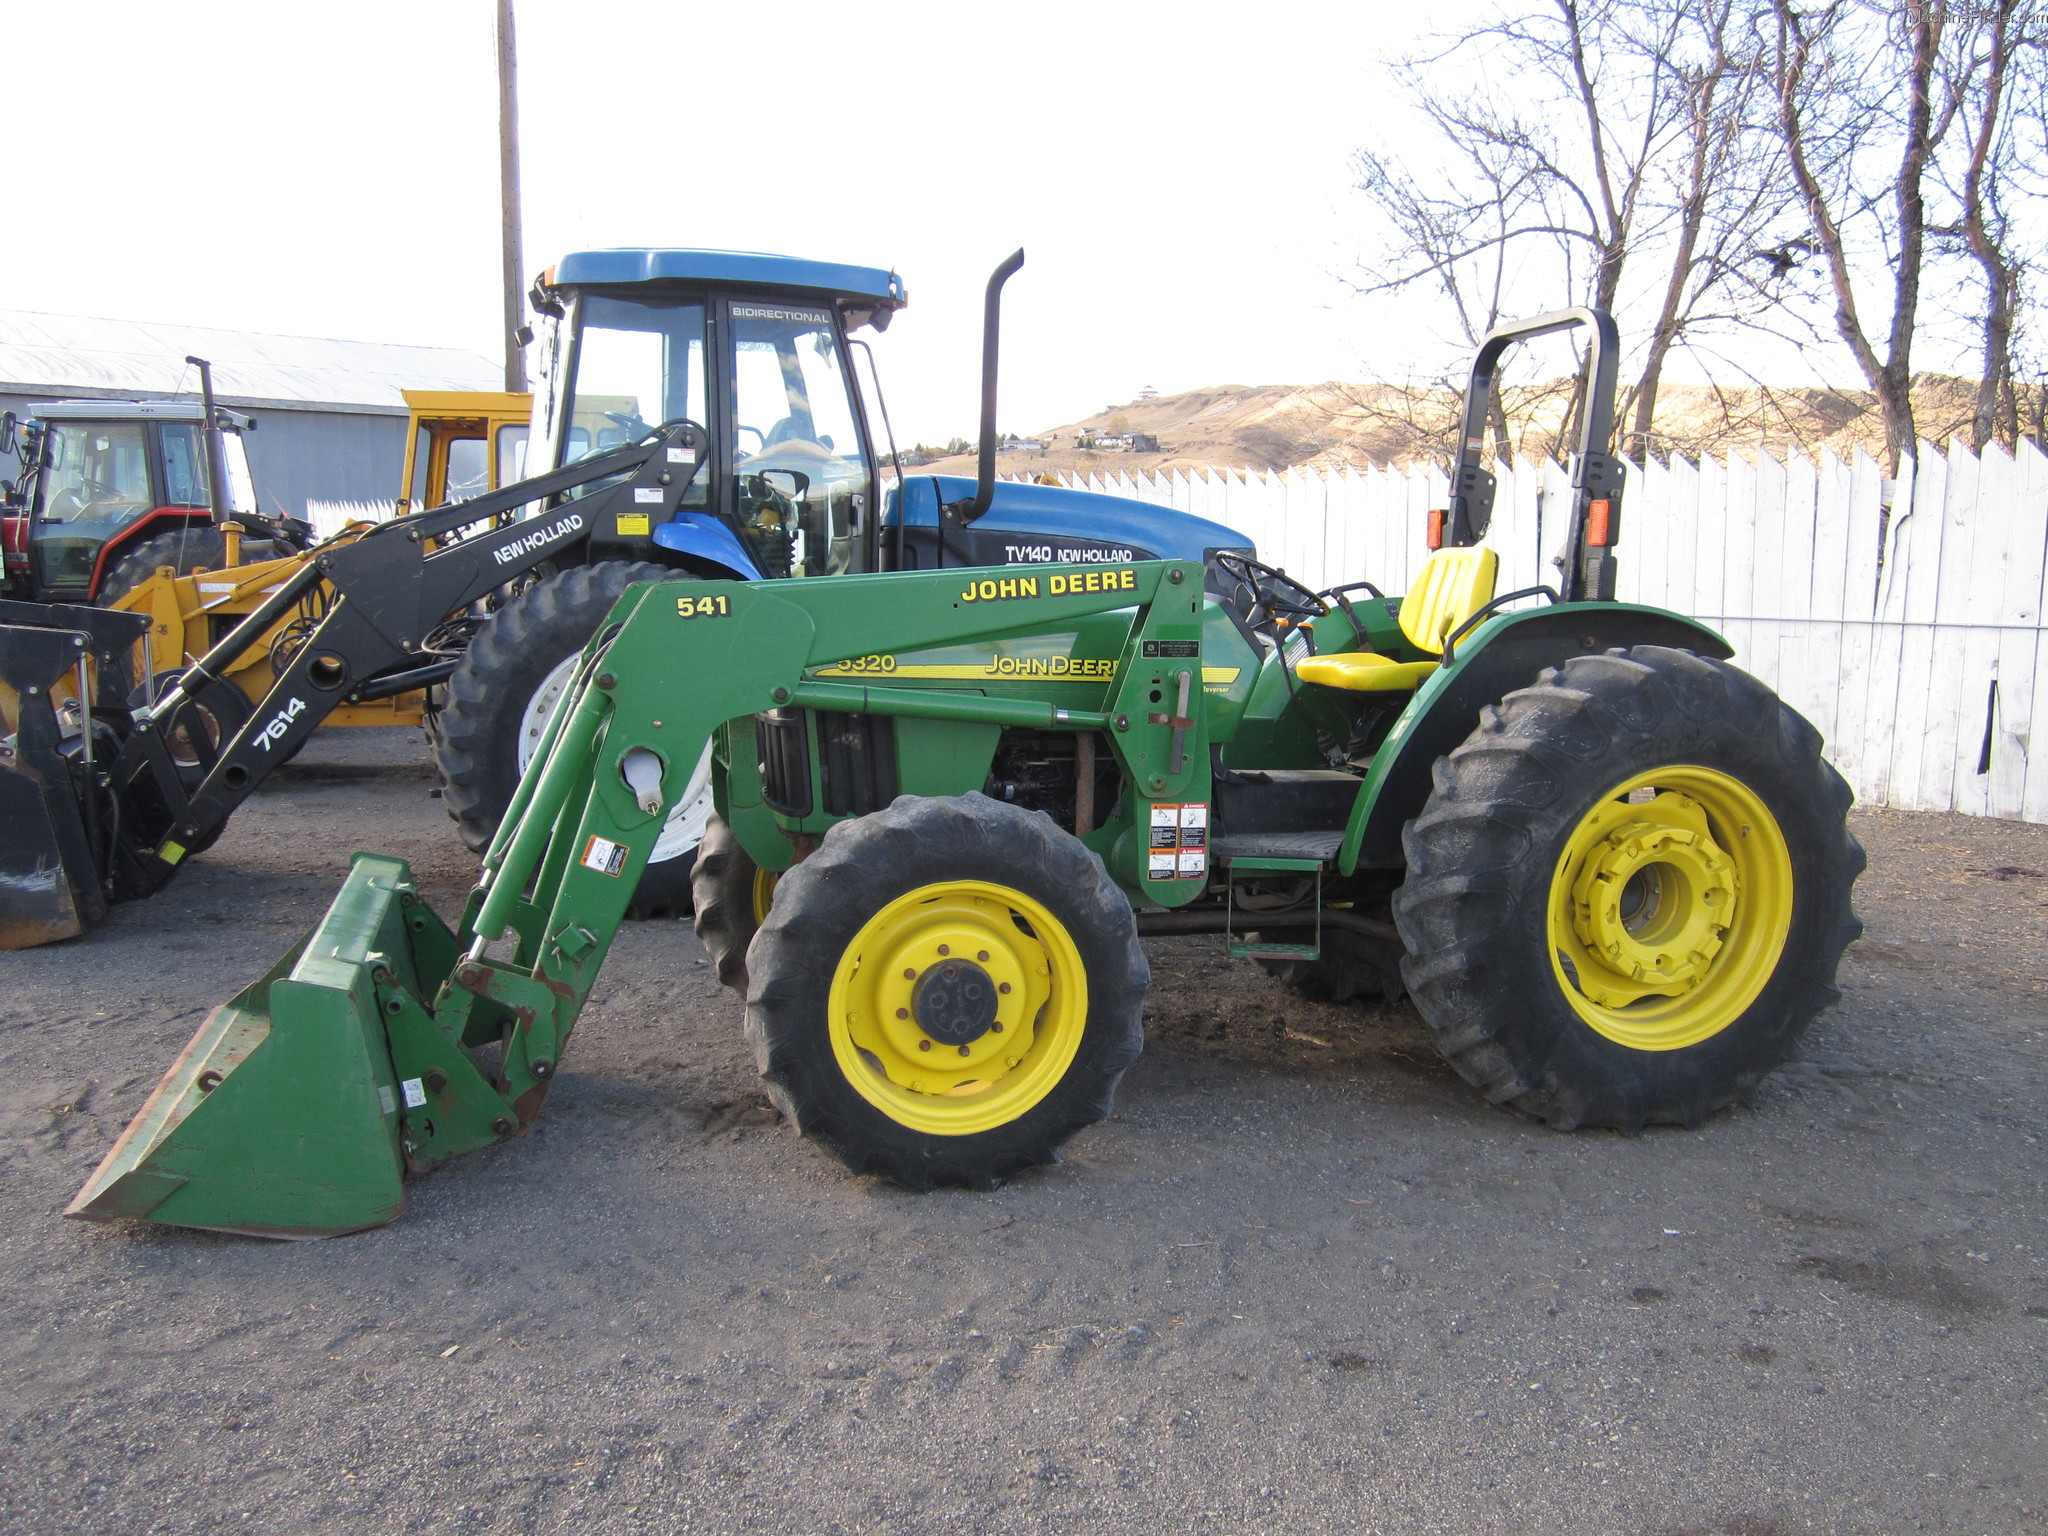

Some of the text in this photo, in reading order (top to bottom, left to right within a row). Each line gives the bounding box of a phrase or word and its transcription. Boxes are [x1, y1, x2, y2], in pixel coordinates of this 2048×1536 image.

[732, 307, 829, 323] BIDIRECTIONAL
[493, 540, 525, 565] NEW
[522, 514, 583, 552] HOLLAND
[1005, 546, 1133, 562] TV140 NEW HOLLAND
[961, 570, 1136, 603] JOHN DEERE
[677, 595, 730, 618] 541
[985, 654, 1048, 674] JOHN
[252, 697, 306, 752] 7614
